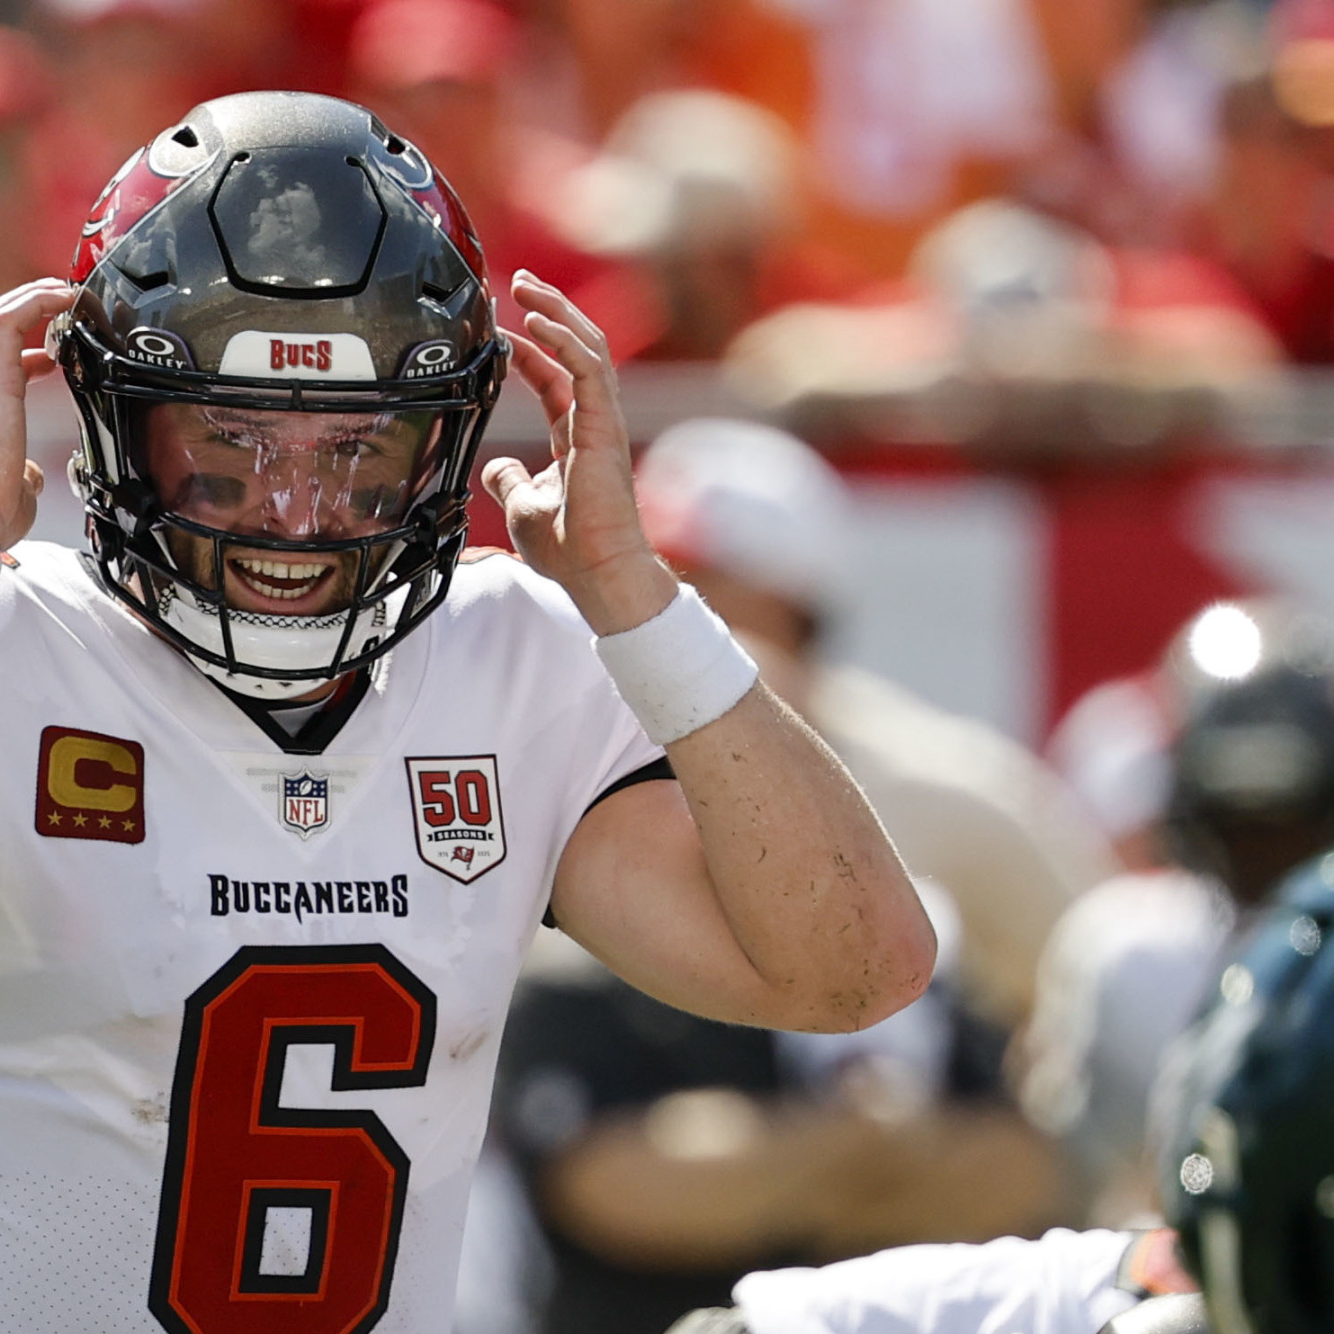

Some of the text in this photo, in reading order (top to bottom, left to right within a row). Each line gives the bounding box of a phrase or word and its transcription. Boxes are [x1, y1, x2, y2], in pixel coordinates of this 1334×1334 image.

[270, 340, 332, 370] BUCS
[406, 360, 456, 379] OAKLEY
[48, 735, 137, 812] C
[288, 798, 324, 825] NFL
[417, 769, 492, 827] 50
[436, 830, 484, 840] SEASONS
[207, 873, 409, 923] BUCCANEERS
